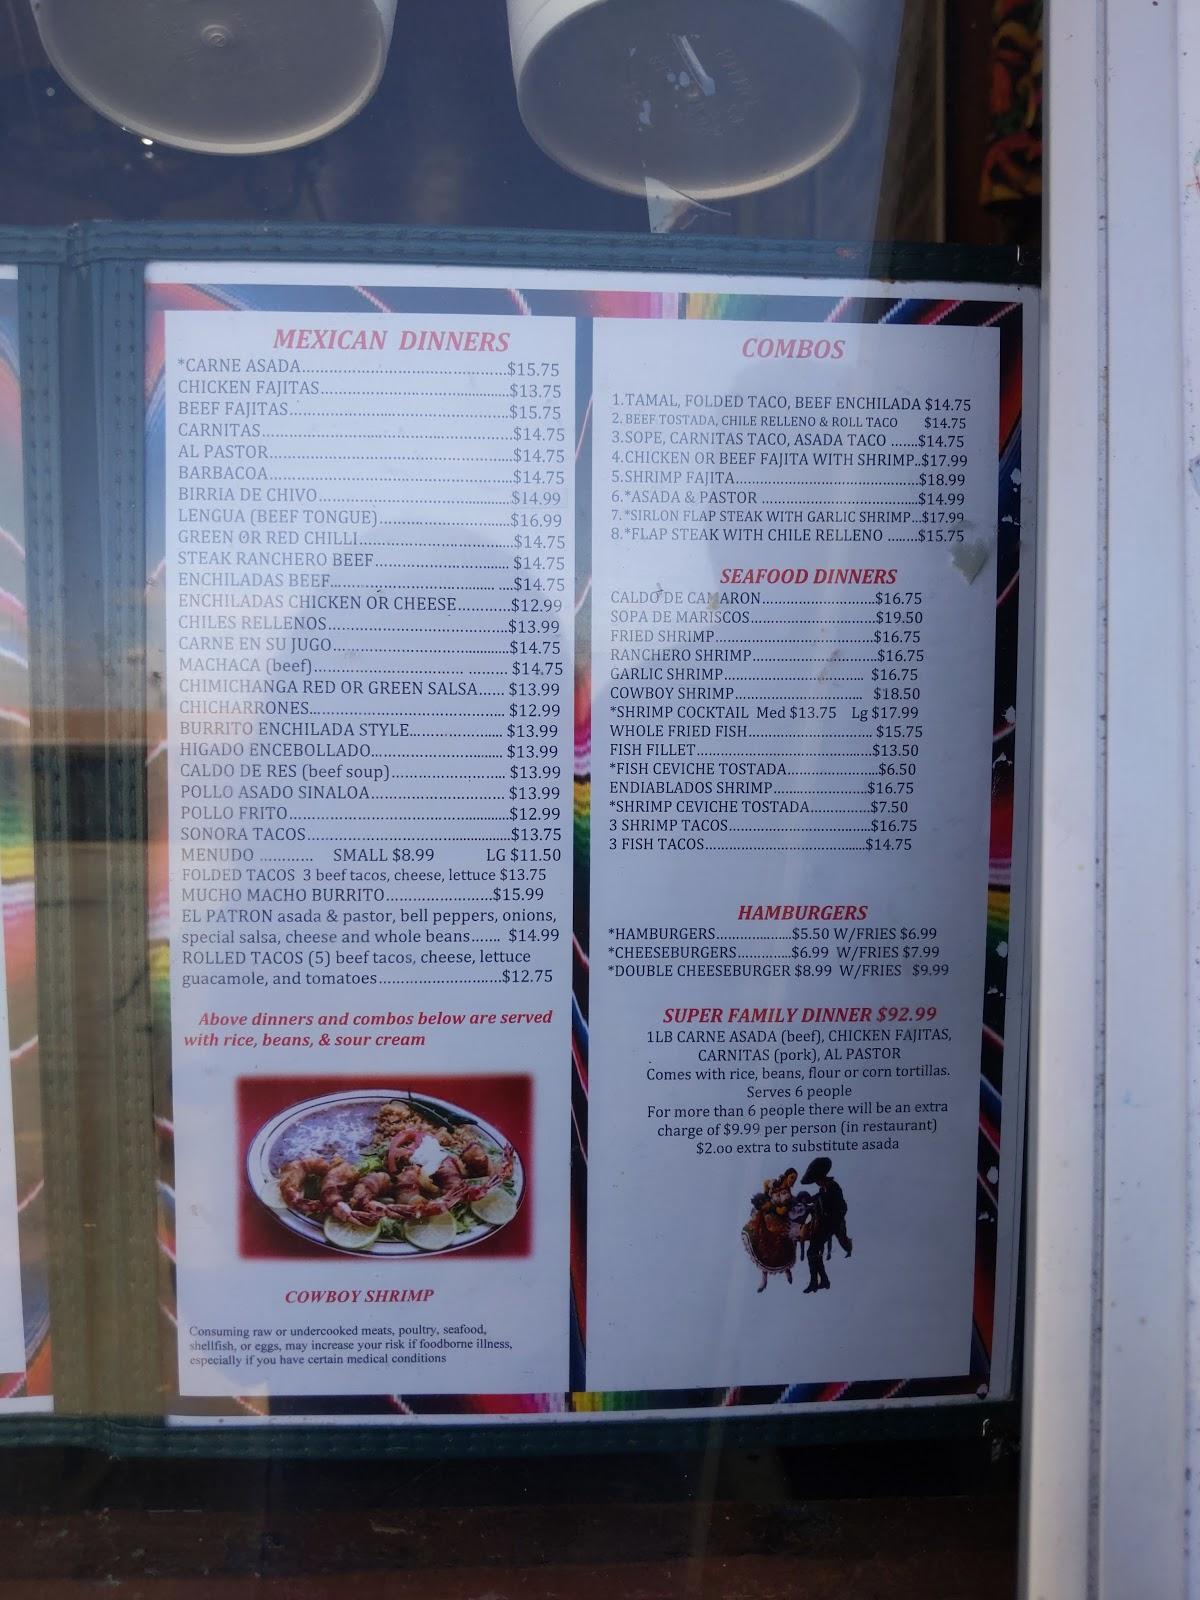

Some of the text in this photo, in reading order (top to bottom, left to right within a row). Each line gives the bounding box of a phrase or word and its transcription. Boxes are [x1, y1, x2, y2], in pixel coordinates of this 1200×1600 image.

[274, 328, 511, 352] MEXICAN DINNERS
[743, 337, 846, 359] COMBOS
[246, 358, 302, 373] ASADA
[508, 360, 560, 378] $15.75
[179, 379, 561, 399] CHICKEN FAJITAS $13.75
[179, 400, 561, 421] BEEF FAJITAS $15.75
[179, 422, 565, 442] CARNITAS $14.75
[178, 444, 565, 464] AL PASTOR $14.75
[687, 471, 735, 486] FAJITA
[919, 472, 966, 488] $18.99
[179, 508, 562, 529] LENGUA (BEEF TONGUE) $16.99
[179, 572, 565, 592] ENCHILADAS BEEF $14.75
[720, 568, 898, 585] SEAFOOD DINNERS
[179, 614, 560, 635] CHILES RELLENOS $13.99
[611, 629, 921, 644] FRIED SHRIMP $16.75
[611, 648, 924, 663] RANCHERO SHRIMP $16.75
[611, 686, 921, 701] COWBOY SHRIMP $18.50
[180, 699, 561, 719] CHICHARRONES $12.99
[678, 705, 749, 719] COCKTAIL
[757, 705, 786, 719] Med
[790, 705, 837, 720] $13.75
[852, 706, 869, 723] Lg
[872, 705, 919, 720] $17.99
[181, 721, 558, 739] BURRITO ENCHILADA STYLE $13.99
[610, 724, 923, 739] WHOLE FRIED FISH $15.75
[610, 780, 914, 795] ENDIABLADOS SHRIMP $16.75
[182, 805, 561, 822] POLLO FRITO $12.99
[181, 826, 562, 842] SONORA TACOS $13.75
[183, 867, 547, 883] FOLDED TACOS 3 beef tacos, cheese, lettuce $13.75
[183, 908, 557, 926] EL PATRON asada & pastor, bell peppers, onions,
[738, 905, 869, 921] HAMBURGERS
[182, 927, 560, 947] special salsa, cheese and whole beans $14.99
[792, 927, 830, 941] $5.50
[834, 927, 897, 942] W/FRIES
[900, 926, 937, 941] $6.99
[792, 945, 829, 960] $6.99
[837, 945, 899, 960] W/FRIES
[903, 944, 940, 959] $7.99
[199, 1009, 553, 1026] Above dinners and combos below are served
[663, 1006, 937, 1024] SUPER FAMILY DINNER $92.99
[185, 1032, 426, 1049] with rice, beans, & sour cream
[647, 1064, 951, 1082] Comes with rice, beans, flour or corn tortillas.
[747, 1084, 853, 1101] Serves 6 people
[286, 1289, 435, 1304] COWBOY SHRIMP
[190, 1323, 487, 1340] Consuming raw or undercooked meats, poultry, seafood,
[191, 1338, 513, 1354] shellfish, or eggs, may increase your risk if foodborne illness,
[190, 1352, 447, 1368] especially if you have certain medical conditions
